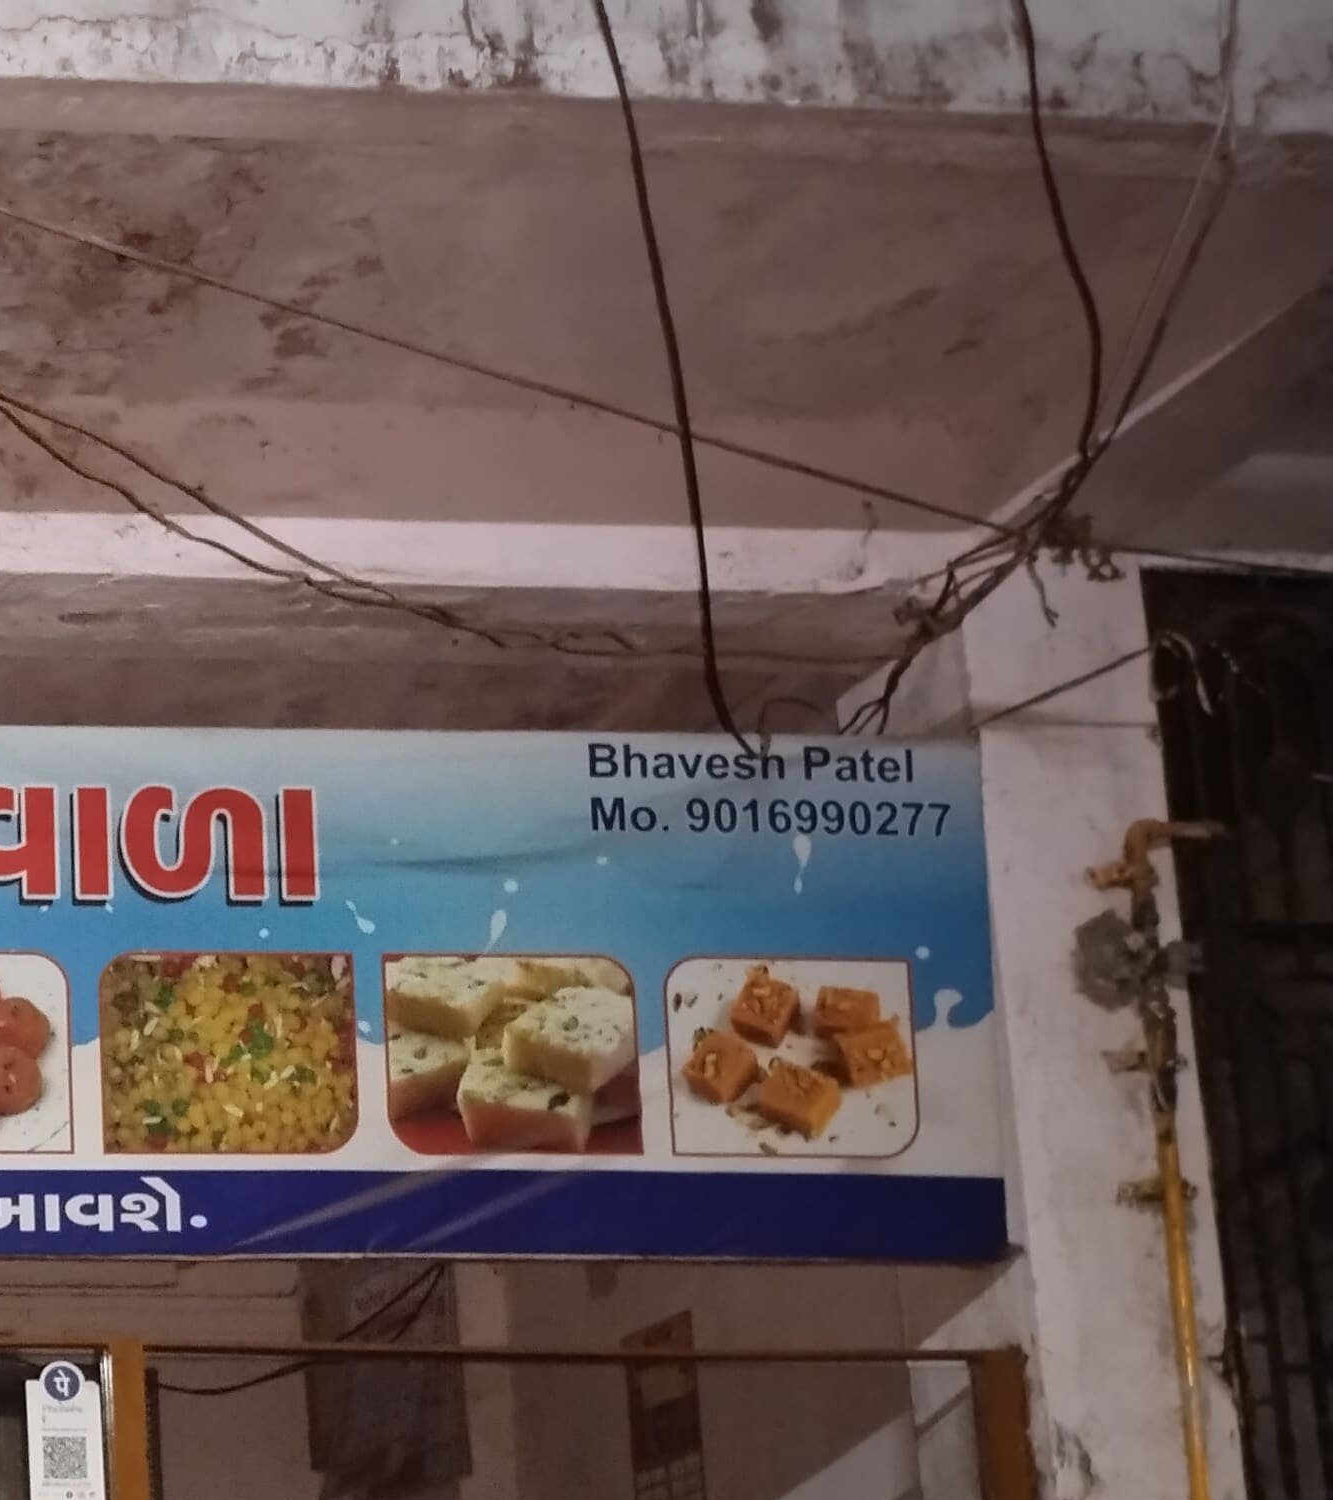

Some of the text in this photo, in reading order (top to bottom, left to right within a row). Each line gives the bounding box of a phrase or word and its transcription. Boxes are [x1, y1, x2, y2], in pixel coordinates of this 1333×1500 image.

[587, 743, 914, 783] Bhavesh Patel
[590, 797, 952, 837] Mo. 9016990277
